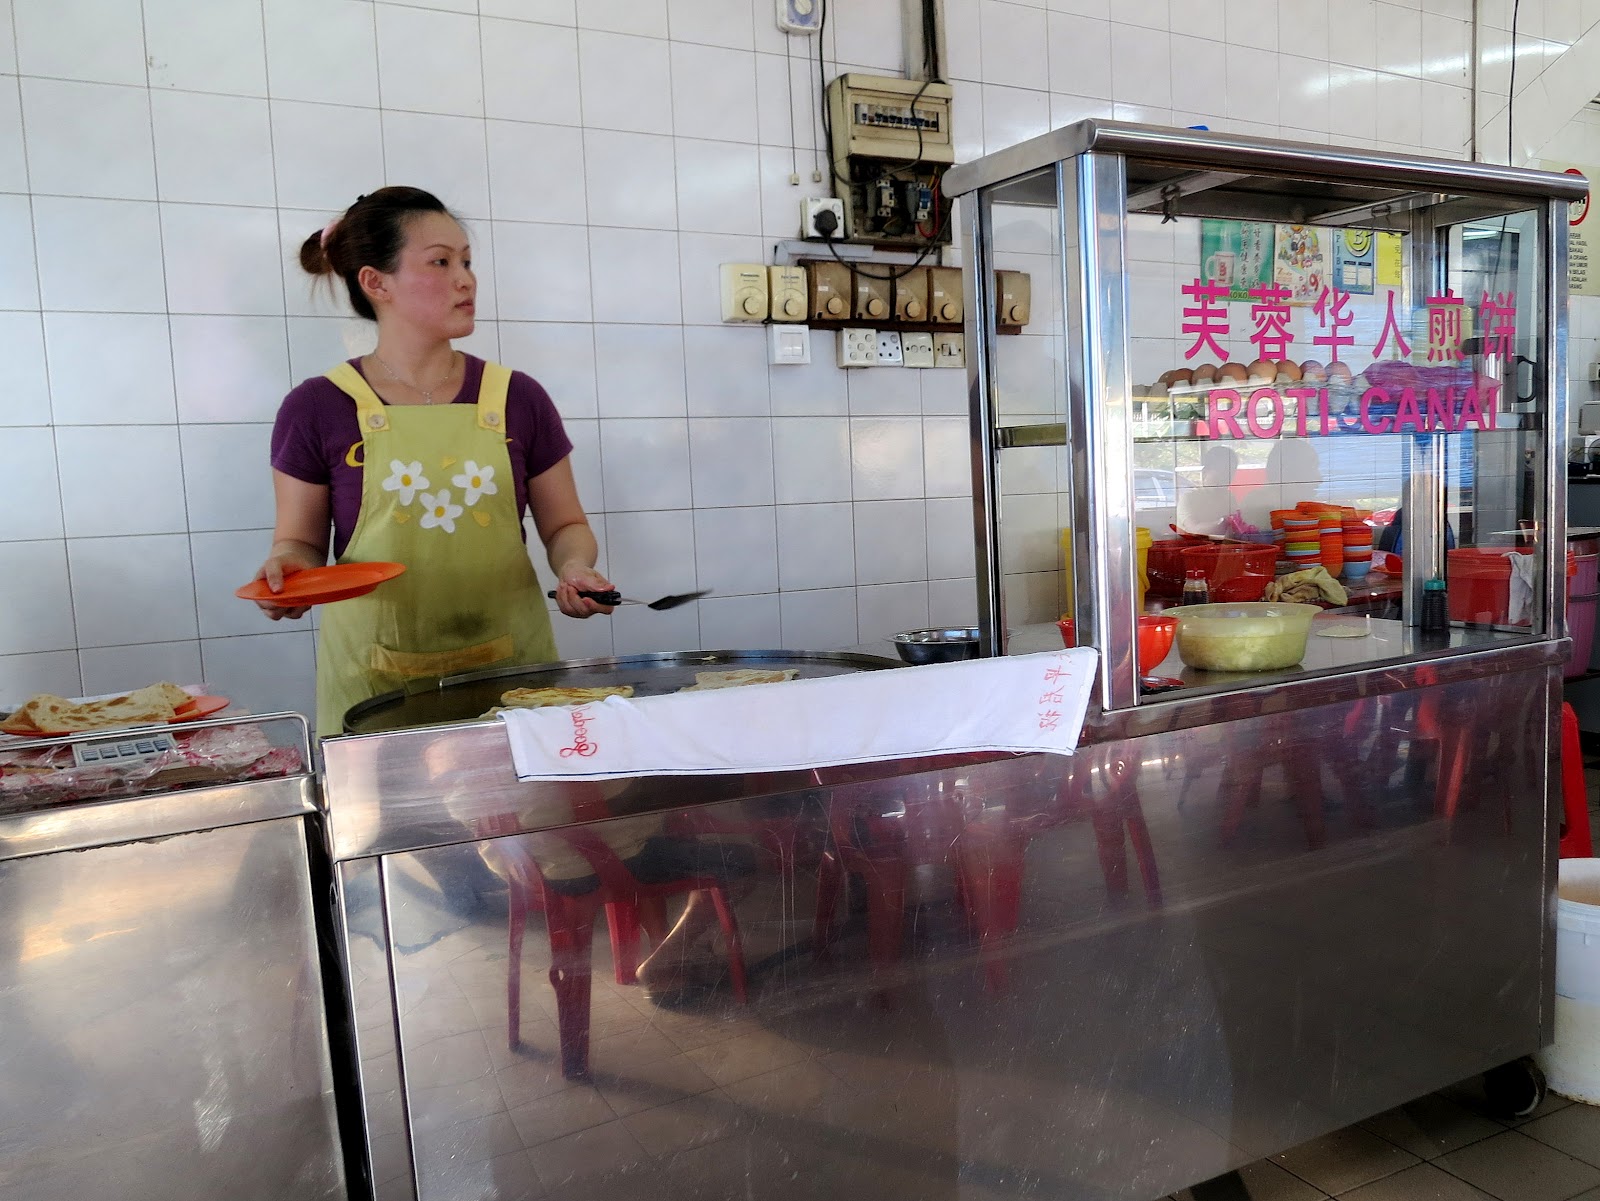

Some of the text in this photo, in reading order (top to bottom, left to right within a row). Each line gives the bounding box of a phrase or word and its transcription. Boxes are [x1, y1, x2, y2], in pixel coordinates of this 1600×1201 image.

[1181, 278, 1516, 364] 芙蓉华人煎饼
[1209, 387, 1499, 440] ROTI CANAI
